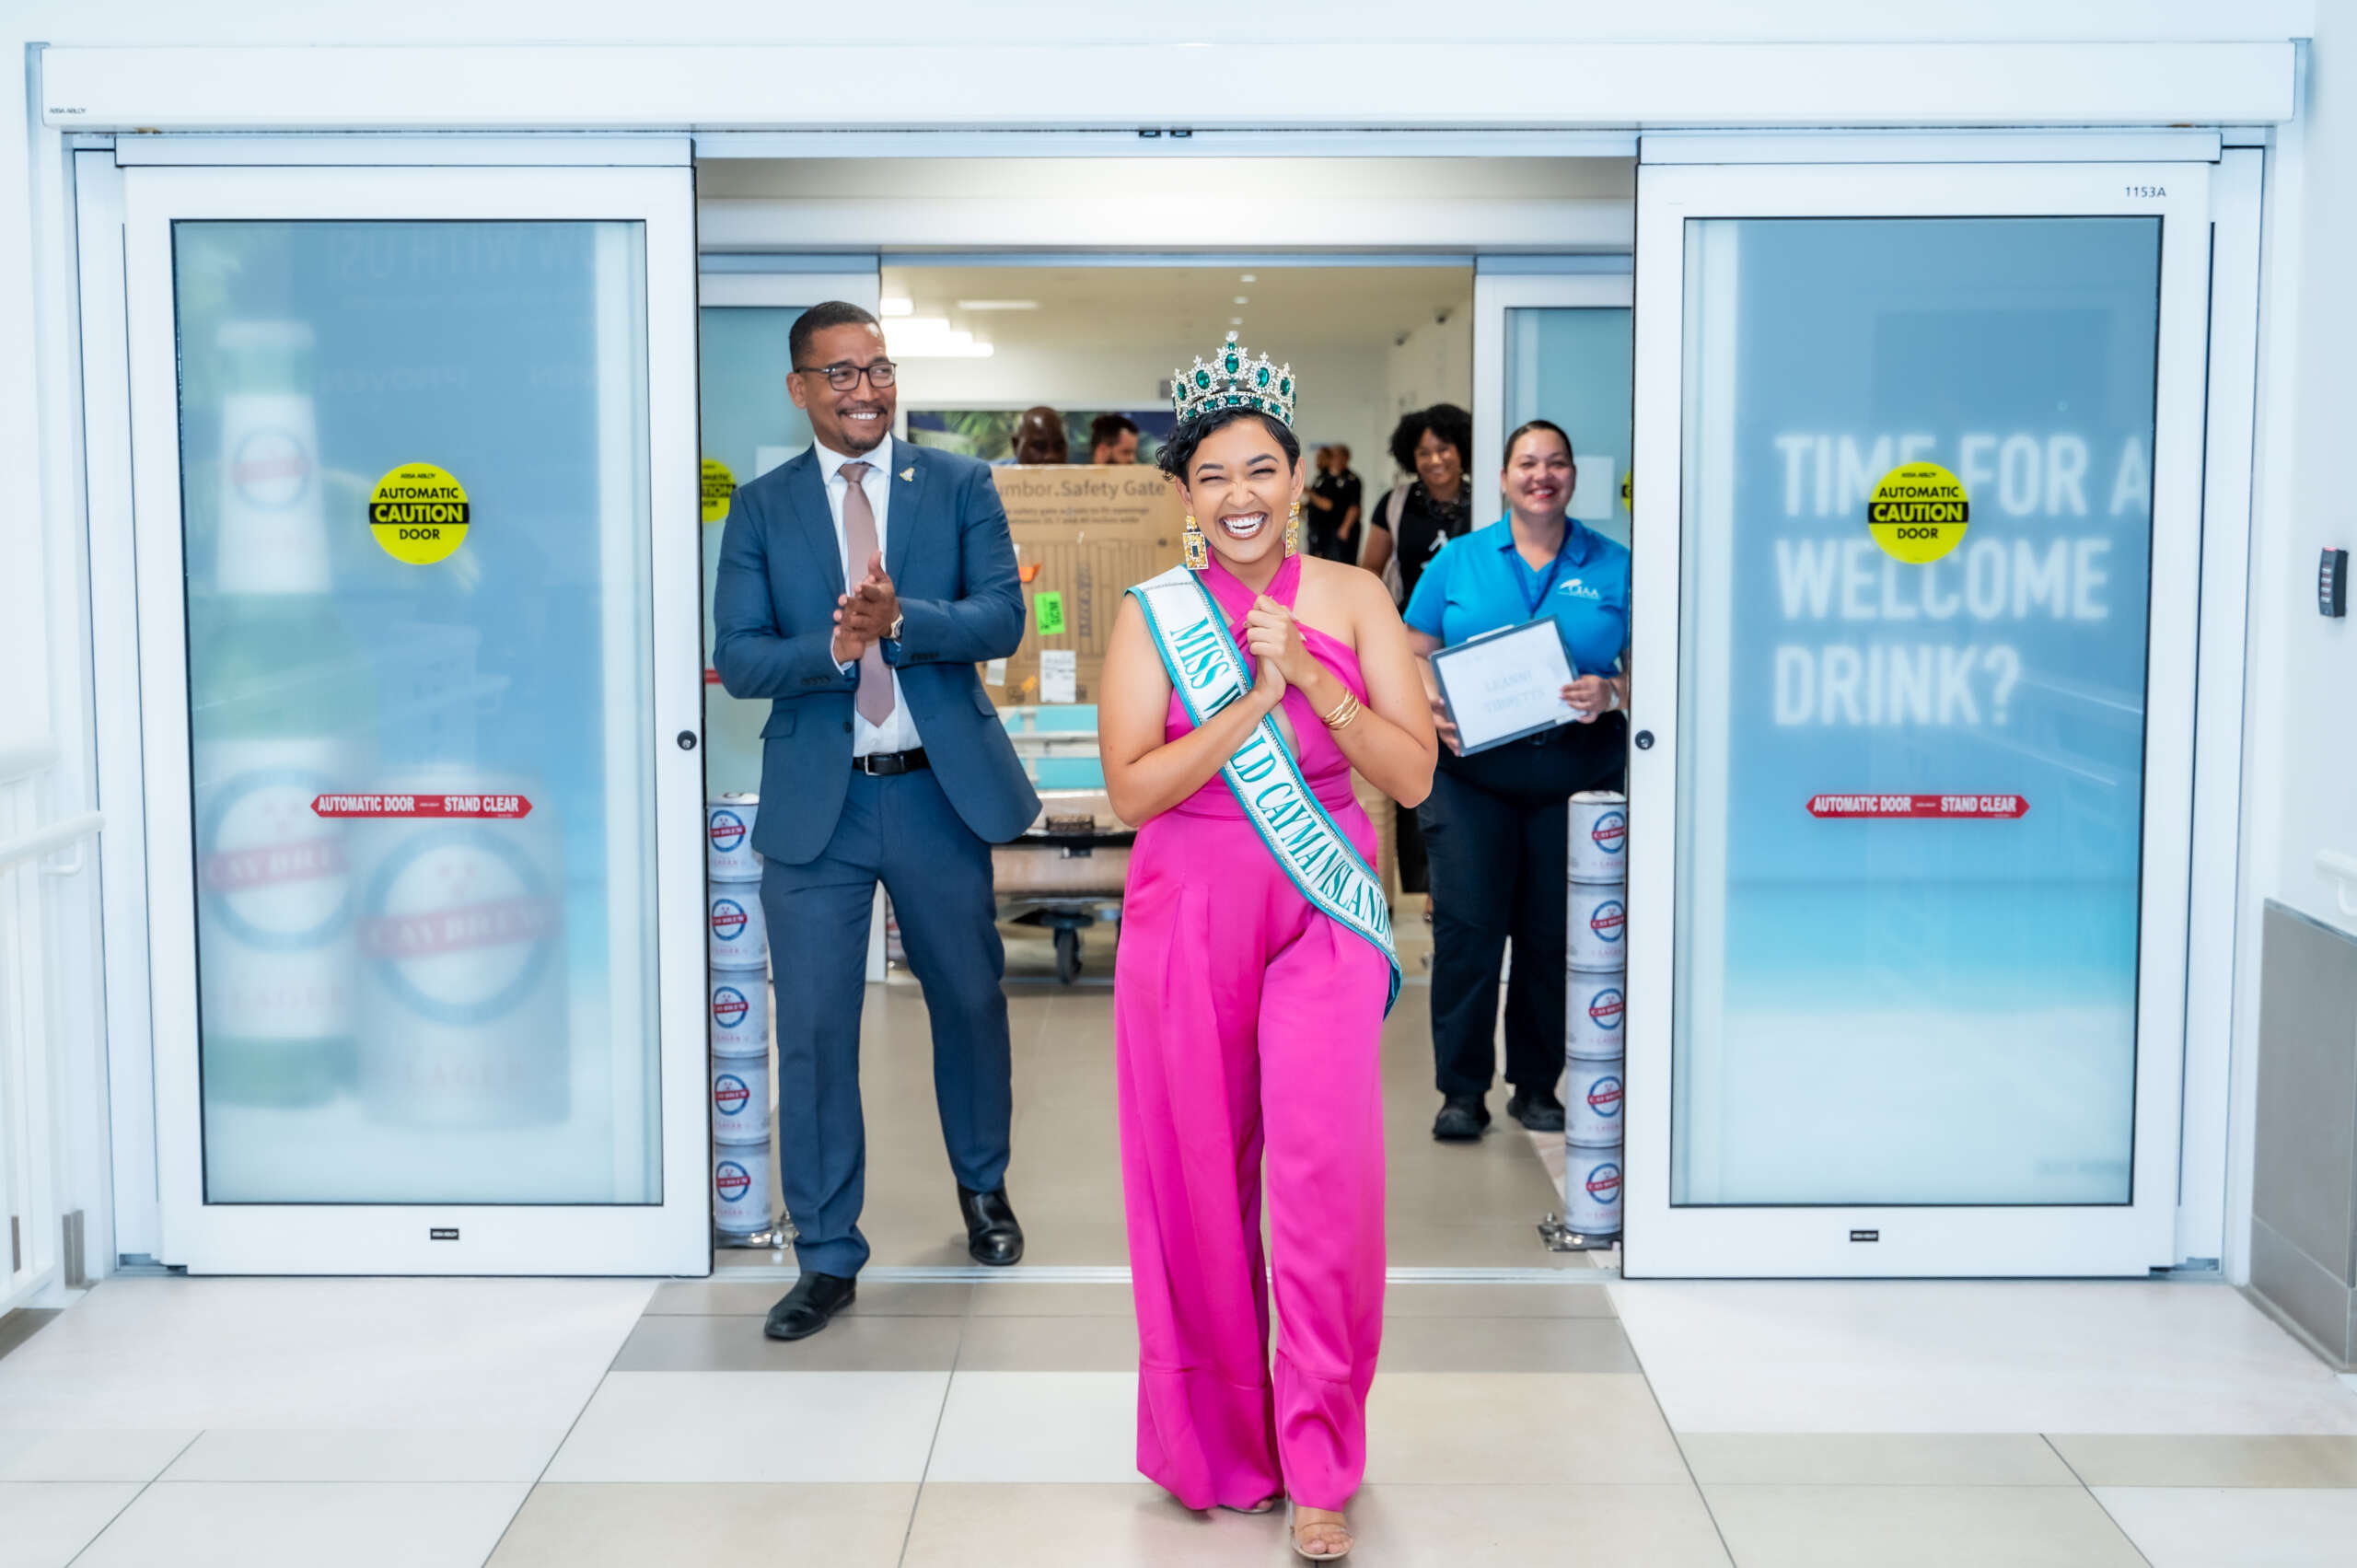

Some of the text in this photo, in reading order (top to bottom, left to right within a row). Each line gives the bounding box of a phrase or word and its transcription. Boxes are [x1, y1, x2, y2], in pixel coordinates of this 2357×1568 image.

[2125, 186, 2166, 199] 1153A
[1960, 435, 2087, 517] FOR
[2110, 435, 2149, 517] A
[379, 487, 459, 499] AUTOMATIC
[1123, 480, 1167, 497] Gate
[1879, 486, 1959, 498] AUTOMATIC
[375, 504, 463, 523] CAUTION
[1873, 503, 1963, 522] CAUTION
[400, 528, 440, 540] DOOR
[1897, 528, 1938, 540] DOOR
[1774, 538, 2111, 621] WELCOME
[1169, 616, 1232, 690] MISS
[1774, 645, 2020, 726] DRINK?
[319, 796, 519, 812] AUTOMATIC DOOR STAND CLEAR
[1814, 796, 2016, 812] AUTOMATIC DOOR STAND CLEAR
